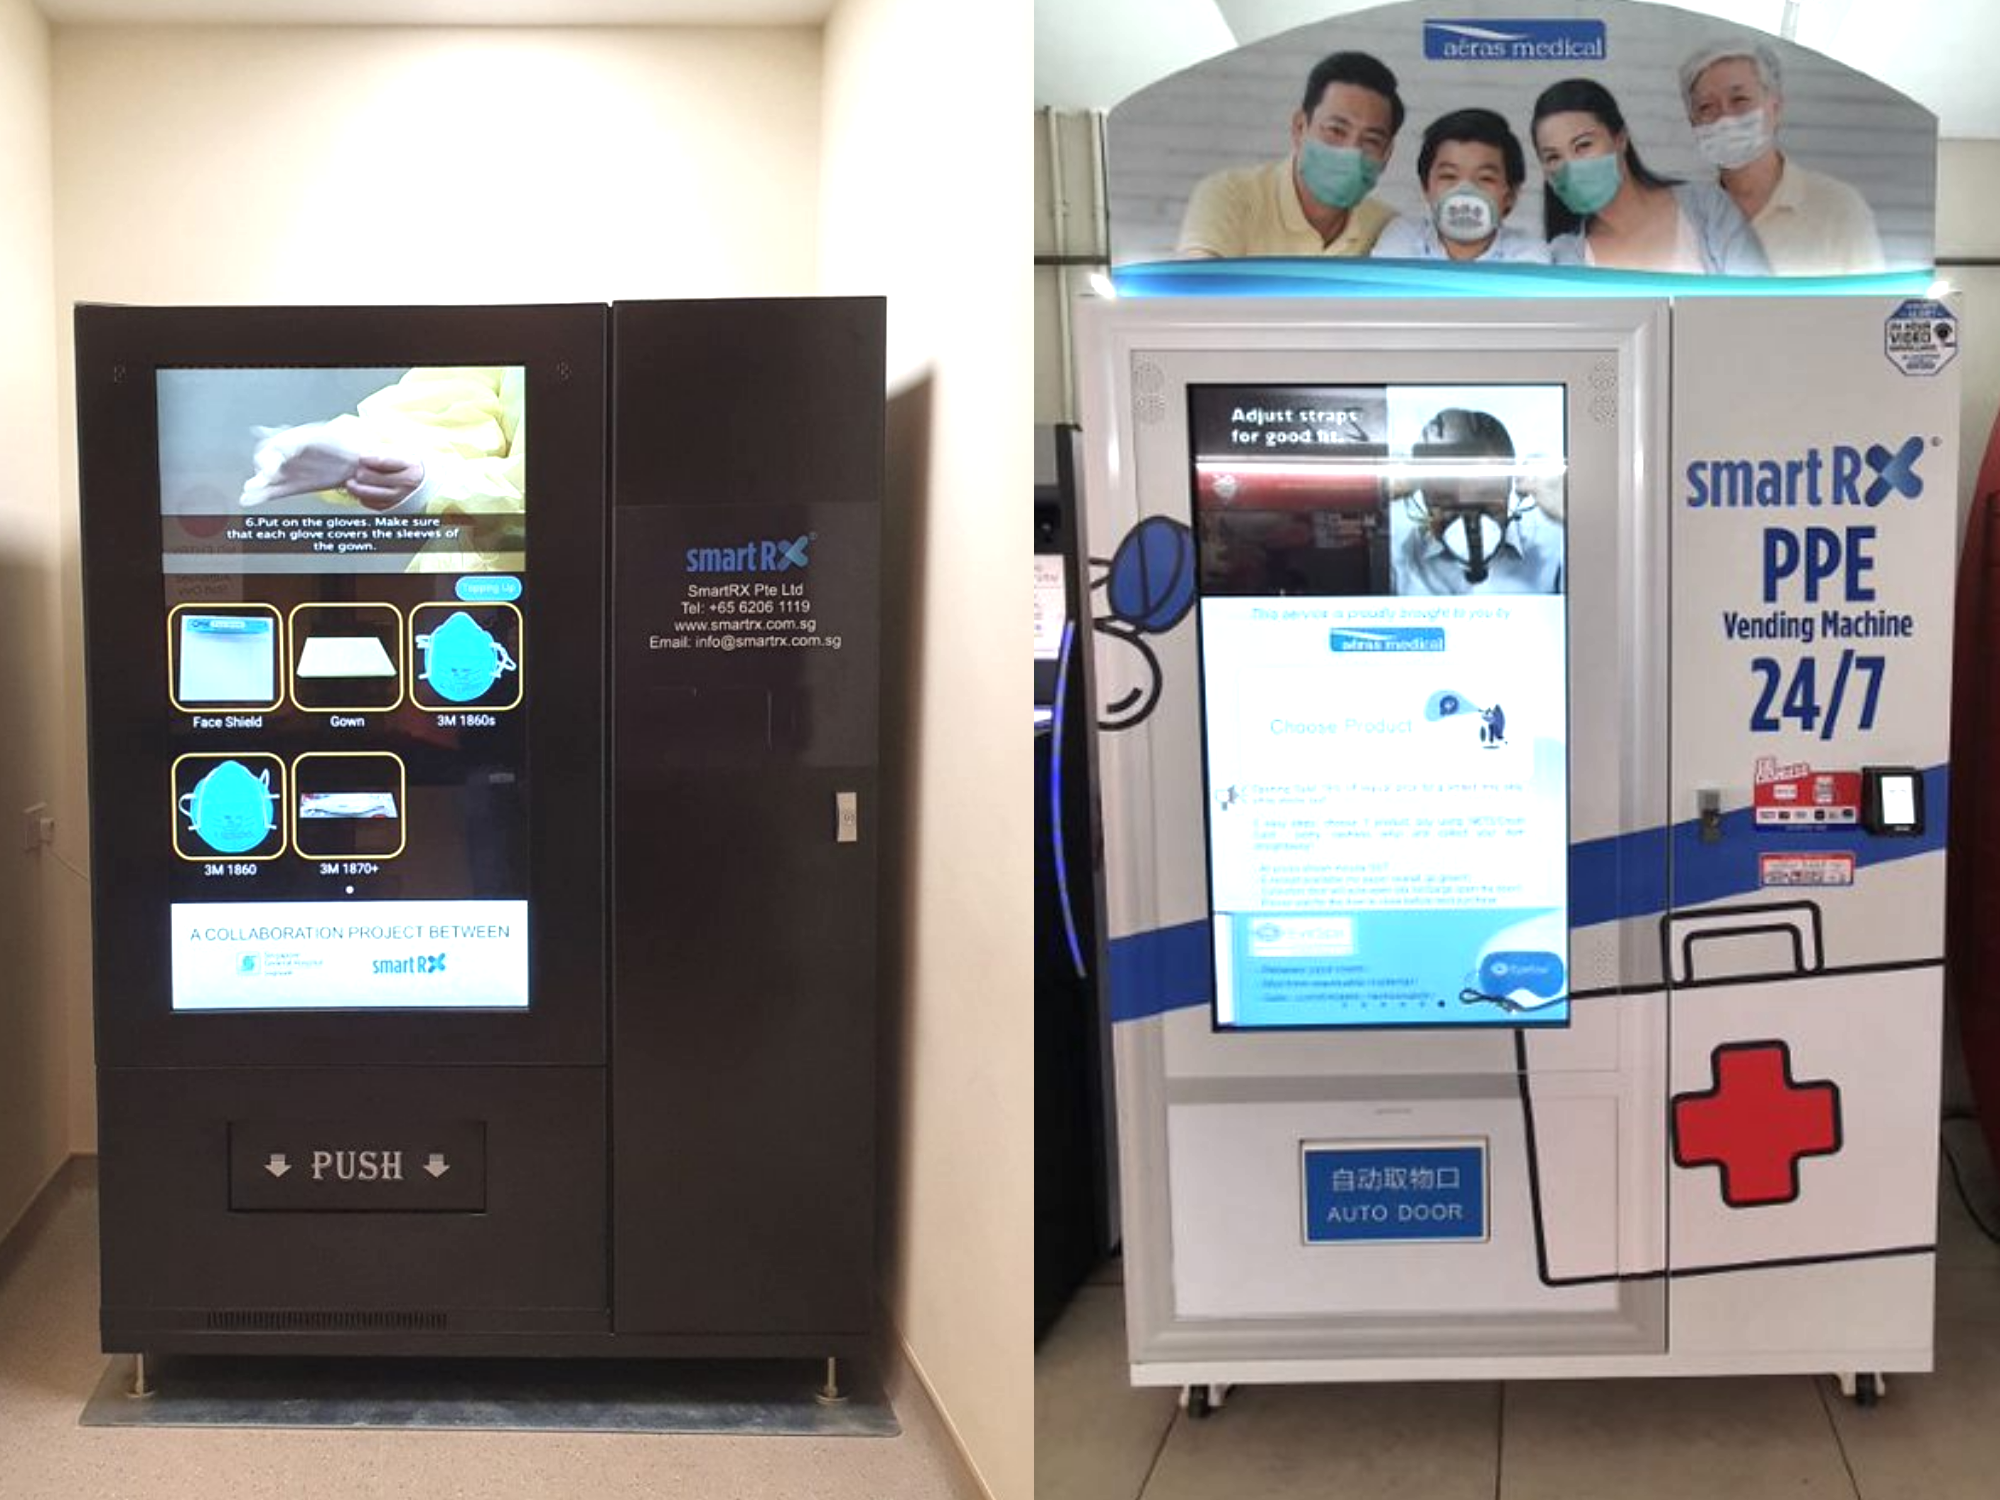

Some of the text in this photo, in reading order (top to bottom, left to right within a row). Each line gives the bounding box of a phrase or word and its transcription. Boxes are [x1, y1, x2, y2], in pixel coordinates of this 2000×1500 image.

[1511, 37, 1602, 57] medical
[1231, 408, 1358, 426] Adjust straps
[1231, 430, 1261, 443] for
[1265, 430, 1310, 446] good
[284, 519, 299, 527] on
[302, 517, 323, 527] the
[326, 516, 370, 530] gloves.
[375, 516, 409, 527] Make
[412, 518, 440, 527] sure
[227, 527, 459, 541] that each glove covers the sleeves of
[313, 540, 377, 554] the gown.
[1763, 525, 1876, 604] PPE
[688, 583, 804, 598] SmartRX Pte Ltd
[682, 600, 810, 615] Tel: +65 6206 1119
[674, 618, 816, 632] www.smartrx.com.sg
[1723, 610, 1913, 643] Vending Machine
[649, 633, 842, 651] Email: info@smartrx.com.sg
[1749, 649, 1886, 741] 24/7
[193, 715, 262, 728] Face Shield
[330, 715, 365, 728] Gown
[437, 715, 496, 727] 3M 1860s
[1270, 717, 1412, 735] Choose Product
[204, 864, 257, 876] 3M 1860
[320, 862, 378, 875] 3M 1870+
[190, 925, 510, 941] A COLLABORATION PROJECT BETWEEN
[311, 1150, 403, 1180] PUSH
[1332, 1166, 1460, 1192] 自动取物口
[1327, 1203, 1463, 1223] AUTO DOOR
